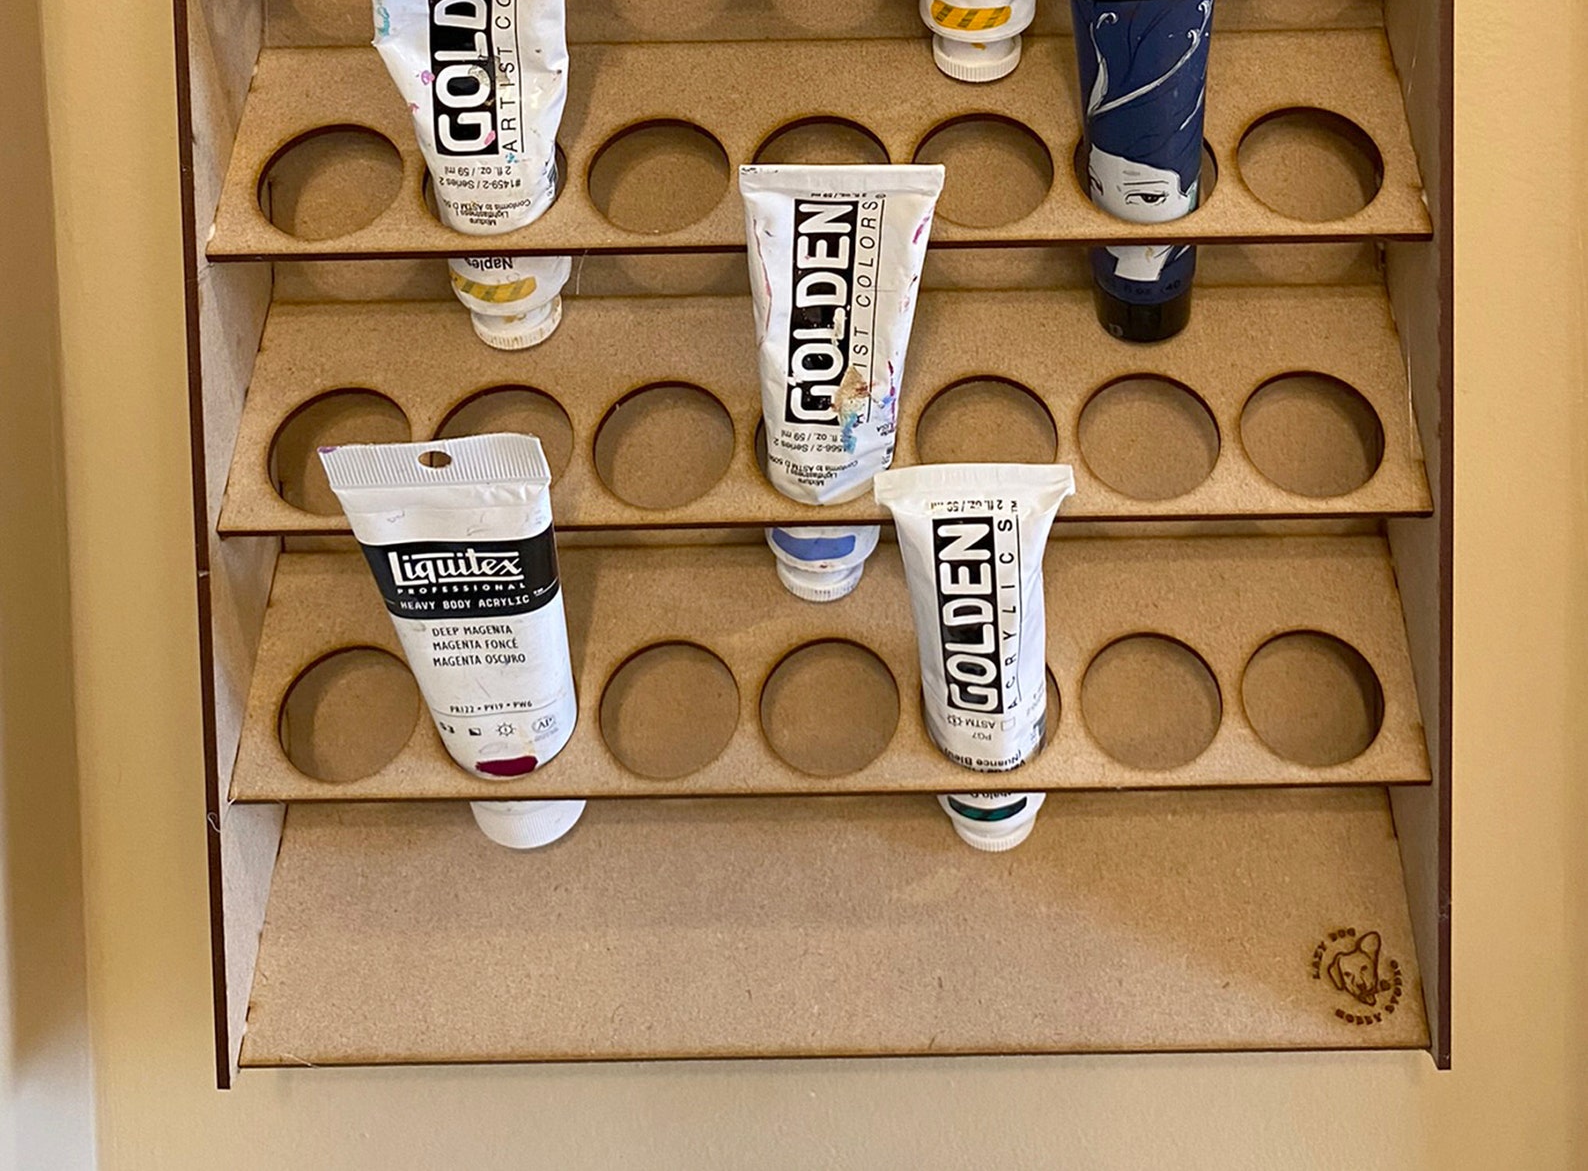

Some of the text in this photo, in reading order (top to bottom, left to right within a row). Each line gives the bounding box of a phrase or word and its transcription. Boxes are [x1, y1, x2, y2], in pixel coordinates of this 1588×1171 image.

[496, 45, 519, 154] ARTIST
[444, 165, 456, 175] ml
[457, 166, 470, 177] 59
[477, 165, 492, 175] oz.
[505, 165, 512, 176] 2
[438, 177, 444, 187] 2
[446, 178, 475, 190] Series
[482, 178, 522, 190] #1459-2
[460, 201, 484, 212] ASTM
[485, 201, 494, 211] to
[494, 198, 531, 211] Conforms
[469, 217, 497, 227] Mixture
[790, 203, 854, 421] GOLDEN
[850, 200, 879, 428] AIST COLORS
[780, 430, 792, 440] ml
[793, 432, 806, 442] 59
[813, 433, 828, 441] oz.
[773, 437, 779, 447] 2
[780, 441, 809, 453] Series
[791, 462, 814, 473] ASTM
[815, 465, 823, 473] to
[996, 499, 1003, 510] 2
[387, 548, 524, 586] Liquitex
[397, 582, 526, 595] PROFESSIONAL
[400, 594, 530, 611] HEAVY BODY ACRYLIC
[937, 523, 998, 712] GOLDEN
[997, 518, 1018, 710] ACRYLICS
[432, 624, 513, 637] DEEP MAGENTA
[432, 637, 519, 651] MAGENTA FONCÉ
[432, 653, 526, 667] MAGENTA OSCURO
[965, 719, 996, 729] ASTM
